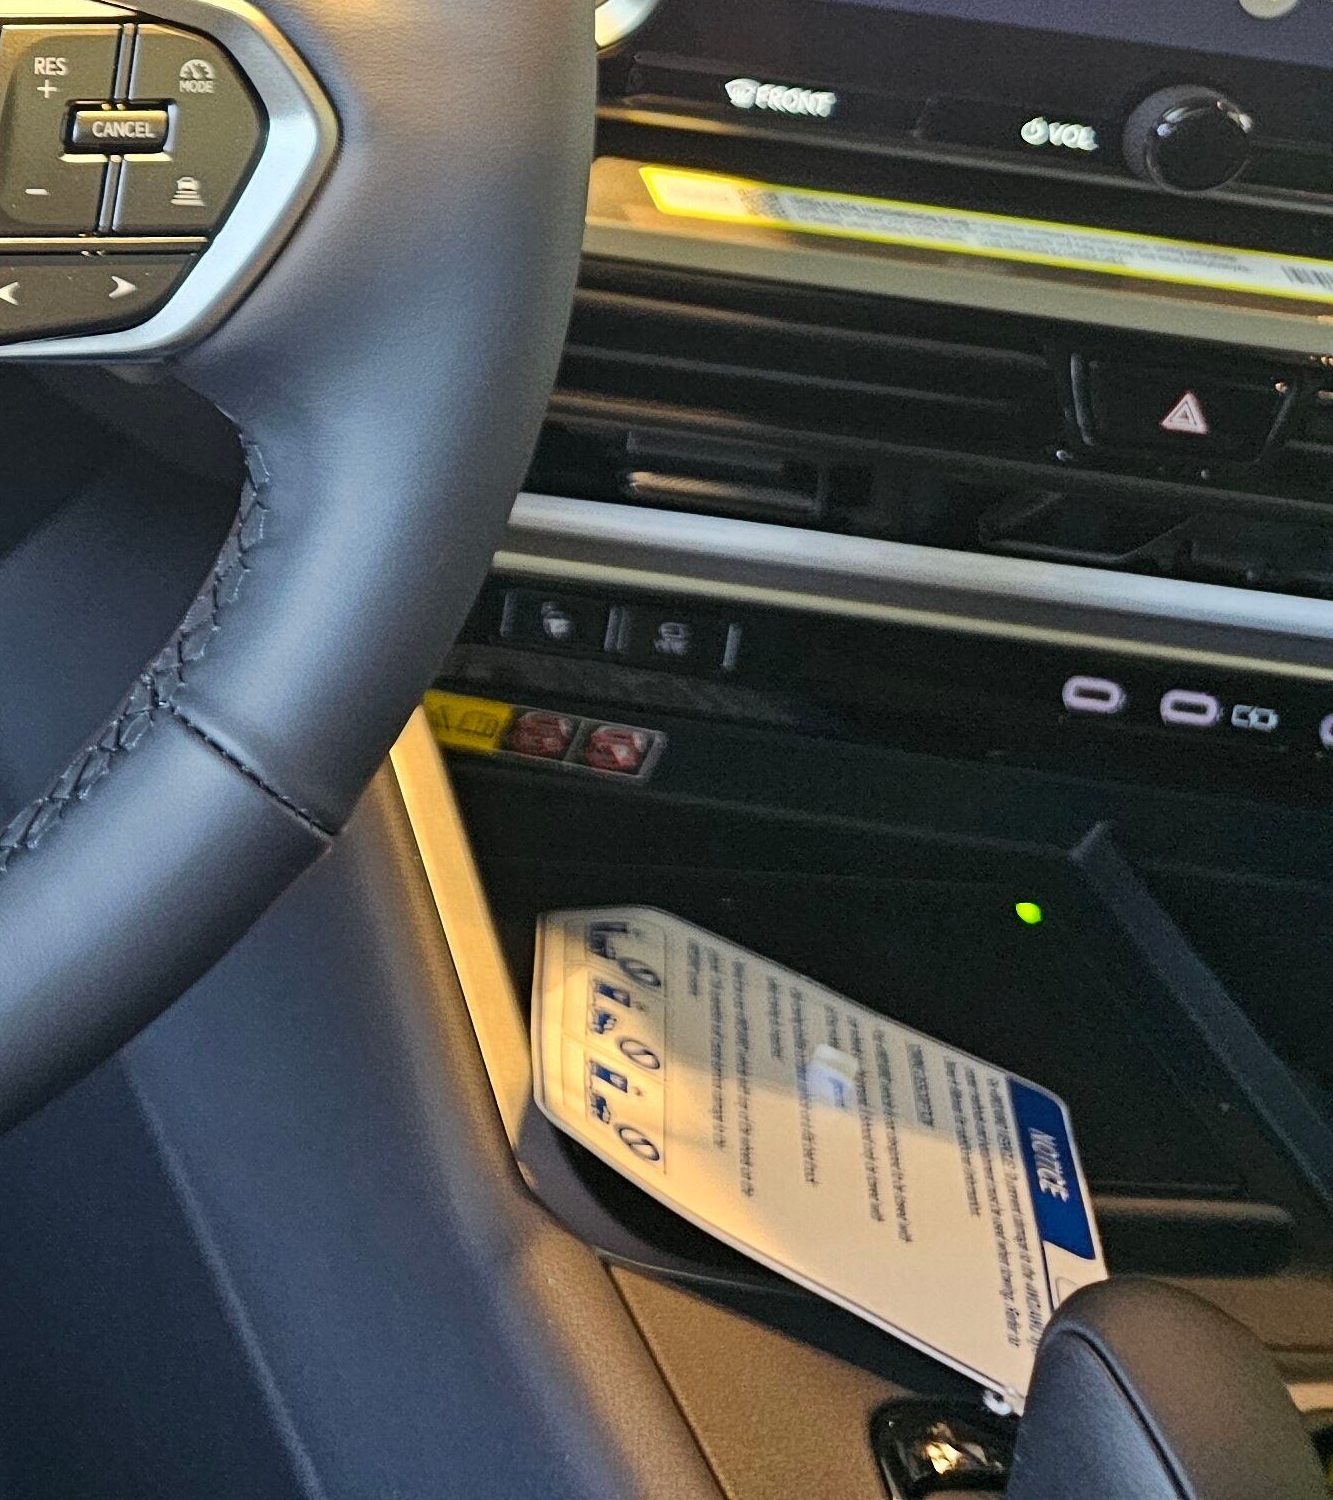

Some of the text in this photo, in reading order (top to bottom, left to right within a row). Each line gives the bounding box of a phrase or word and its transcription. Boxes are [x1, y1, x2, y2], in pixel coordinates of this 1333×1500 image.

[33, 56, 68, 76] RES
[178, 78, 215, 94] MODE
[755, 83, 837, 118] FRONT
[91, 120, 156, 138] CANCEL
[1049, 122, 1099, 152] VOL
[1029, 1127, 1070, 1203] NOTICE
